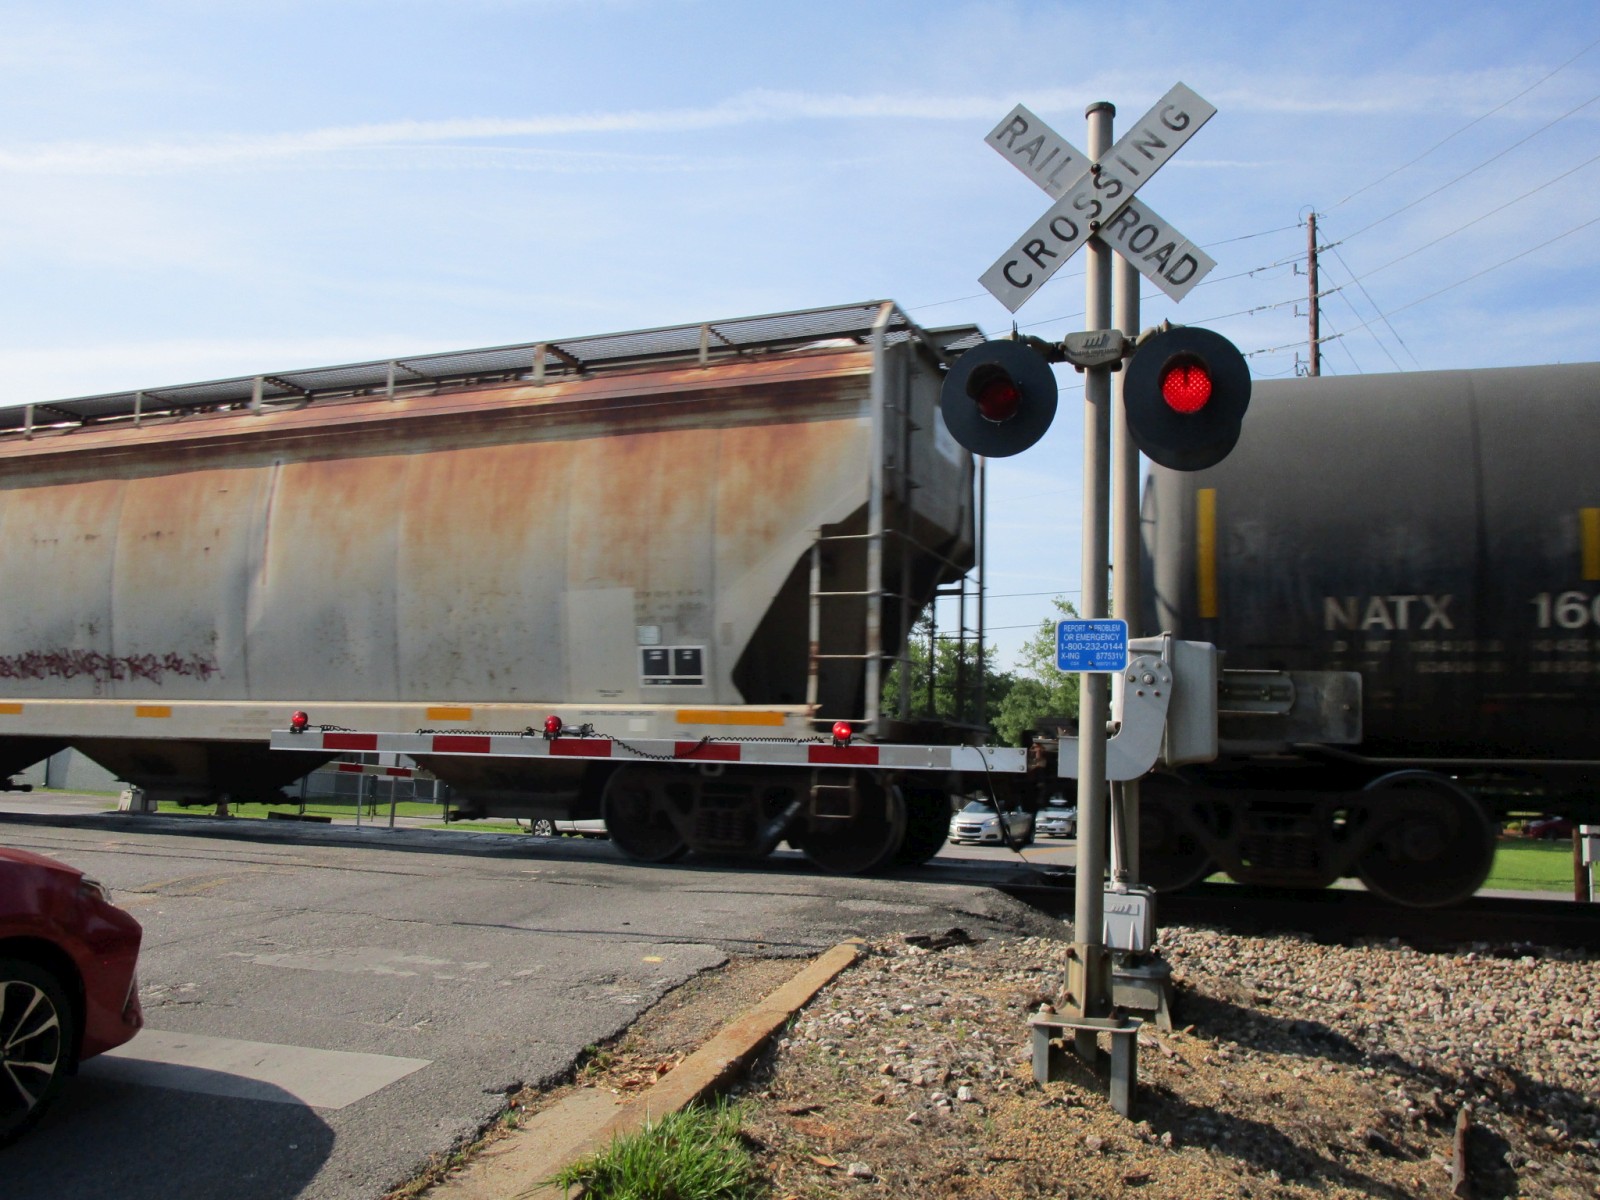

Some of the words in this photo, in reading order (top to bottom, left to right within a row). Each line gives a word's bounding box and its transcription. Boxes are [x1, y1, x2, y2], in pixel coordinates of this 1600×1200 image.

[996, 115, 1072, 192] RAIL
[1106, 205, 1198, 286] ROAD
[1003, 104, 1190, 288] CROSSING
[1324, 595, 1454, 630] NATX
[1063, 624, 1086, 632] REPORT
[1094, 624, 1120, 632] PROBLEM
[1063, 633, 1074, 641] OR
[1075, 633, 1120, 641] EMERGENCY
[1061, 642, 1123, 651] 1-800-232-0144
[1061, 652, 1080, 660] X-ING
[1095, 652, 1124, 660] 877531V
